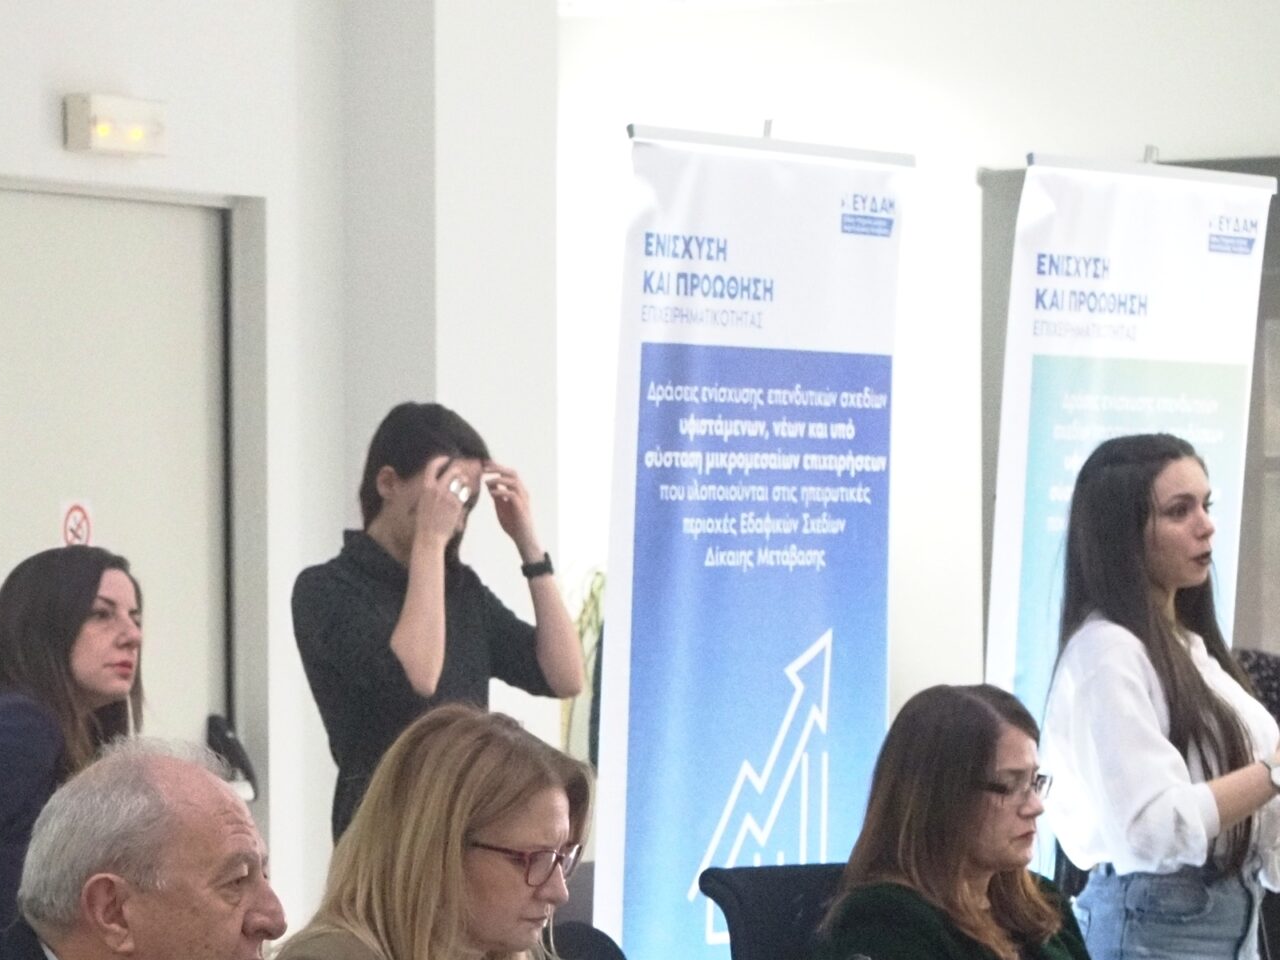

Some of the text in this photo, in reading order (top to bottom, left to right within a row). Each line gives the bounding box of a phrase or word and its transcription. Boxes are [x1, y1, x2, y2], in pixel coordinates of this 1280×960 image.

[644, 232, 728, 262] ΕΝΙΣΧΥΣΗ
[1036, 253, 1110, 279] ΕΝΙΣΧΥΣΗ
[643, 270, 774, 302] ΚΑΙ ΠΡΟΩΘΗΣΗ
[1035, 288, 1148, 316] ΚΑΙ ΠΡΟΩΘΗΣΗ
[647, 380, 699, 407] Δράσεις
[700, 382, 764, 410] ενίσχυσης
[808, 422, 828, 439] και
